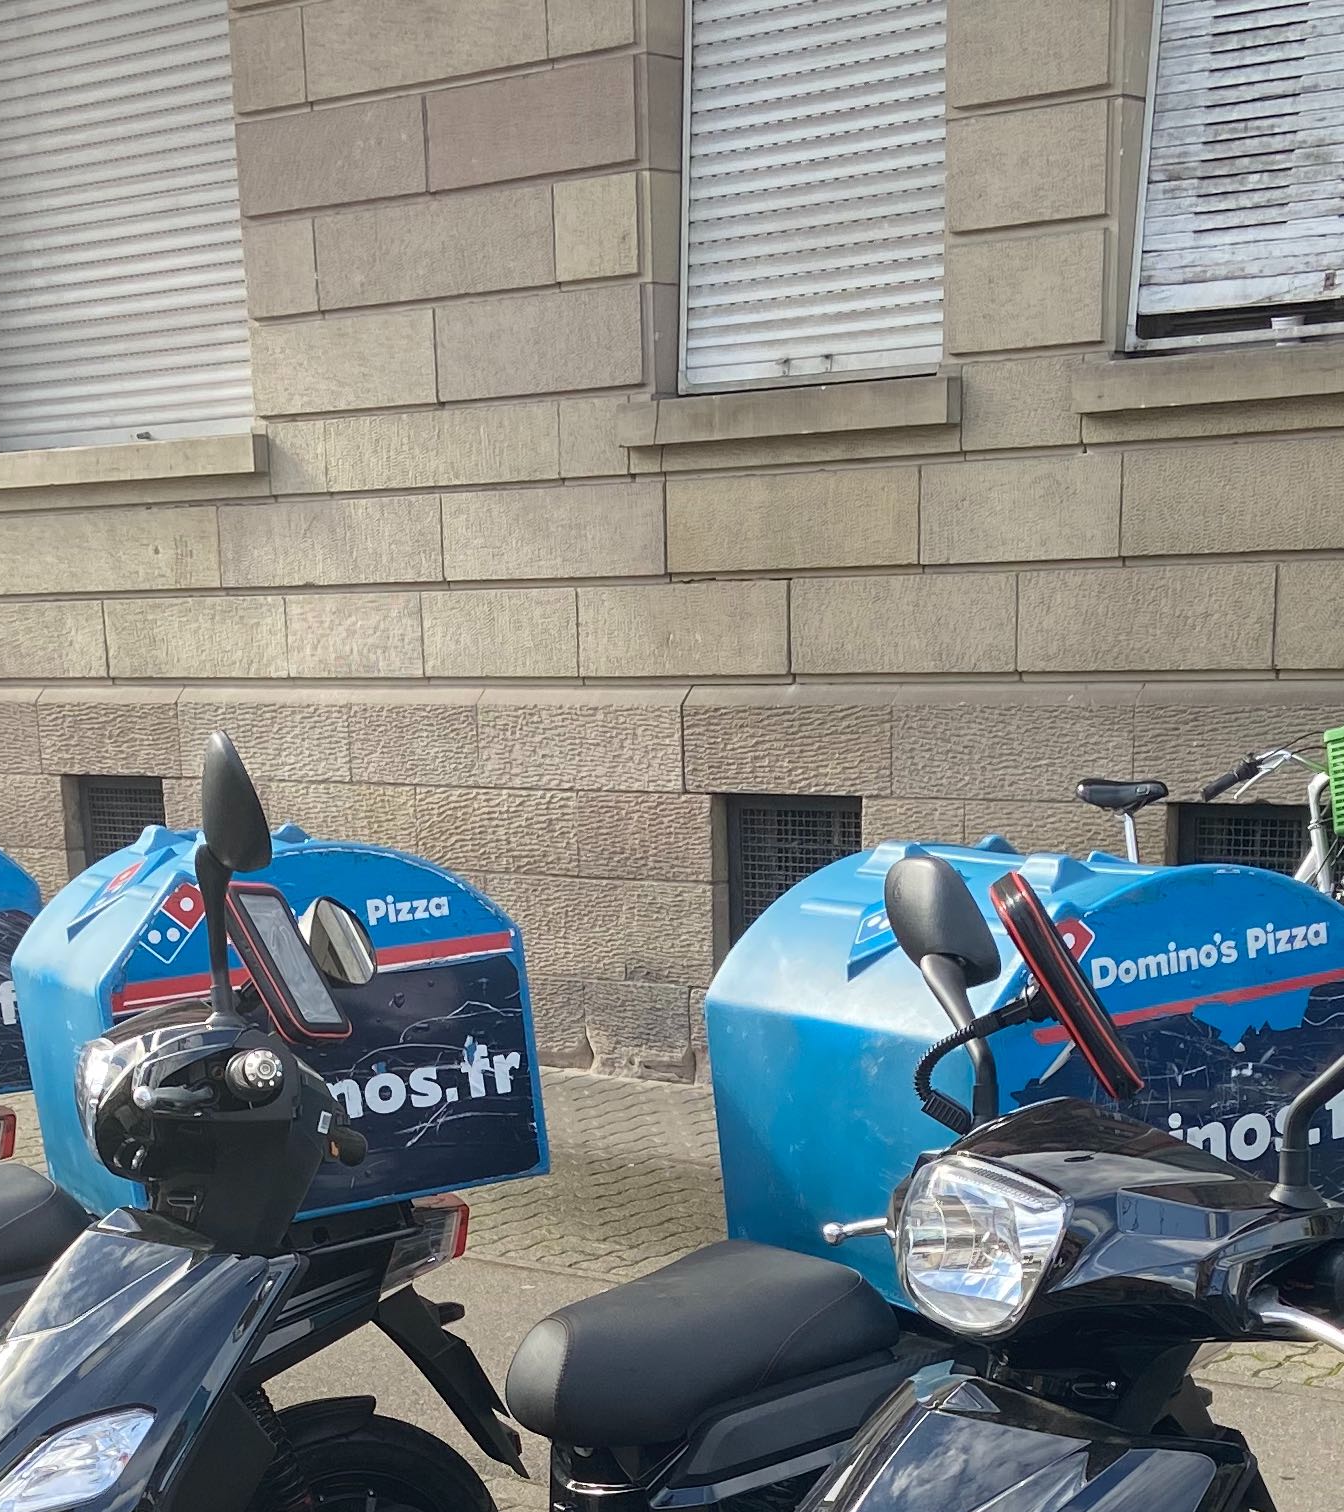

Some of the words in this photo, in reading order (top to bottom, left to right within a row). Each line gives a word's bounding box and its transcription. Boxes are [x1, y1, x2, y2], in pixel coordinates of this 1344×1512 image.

[367, 895, 451, 927] Pizza
[1092, 932, 1238, 989] Domino's
[1246, 922, 1329, 960] Pizza
